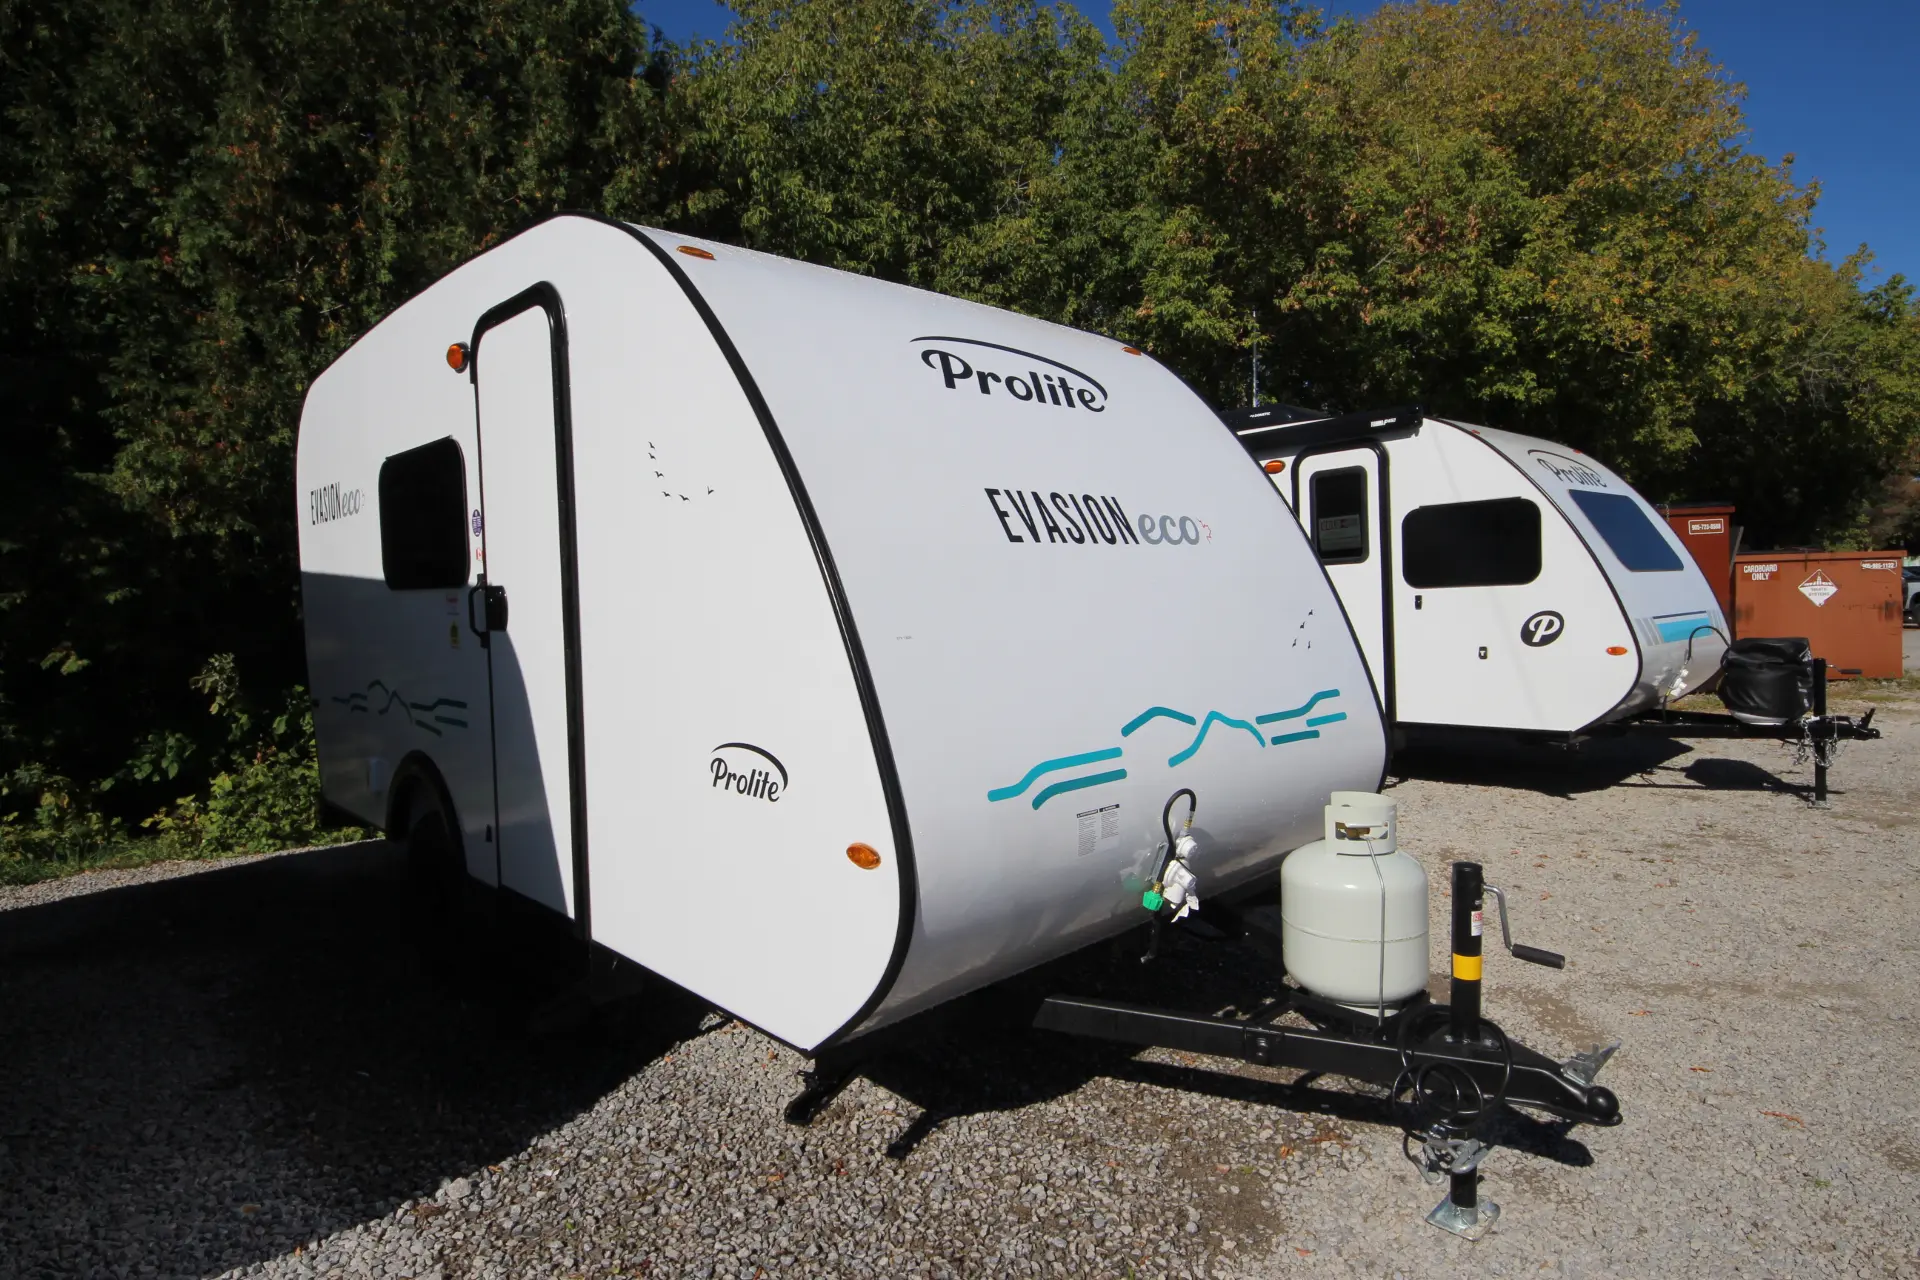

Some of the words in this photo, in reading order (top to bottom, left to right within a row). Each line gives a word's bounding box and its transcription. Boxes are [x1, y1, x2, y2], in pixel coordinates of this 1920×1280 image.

[920, 349, 1105, 413] Prolite
[1537, 458, 1607, 488] Prolite
[310, 481, 342, 525] EVASION
[984, 488, 1140, 545] EVASION
[1138, 513, 1200, 546] eco
[1743, 564, 1778, 573] CARDBOARD
[1751, 572, 1770, 581] ONLY
[1529, 615, 1560, 643] P
[710, 757, 780, 803] Prolite
